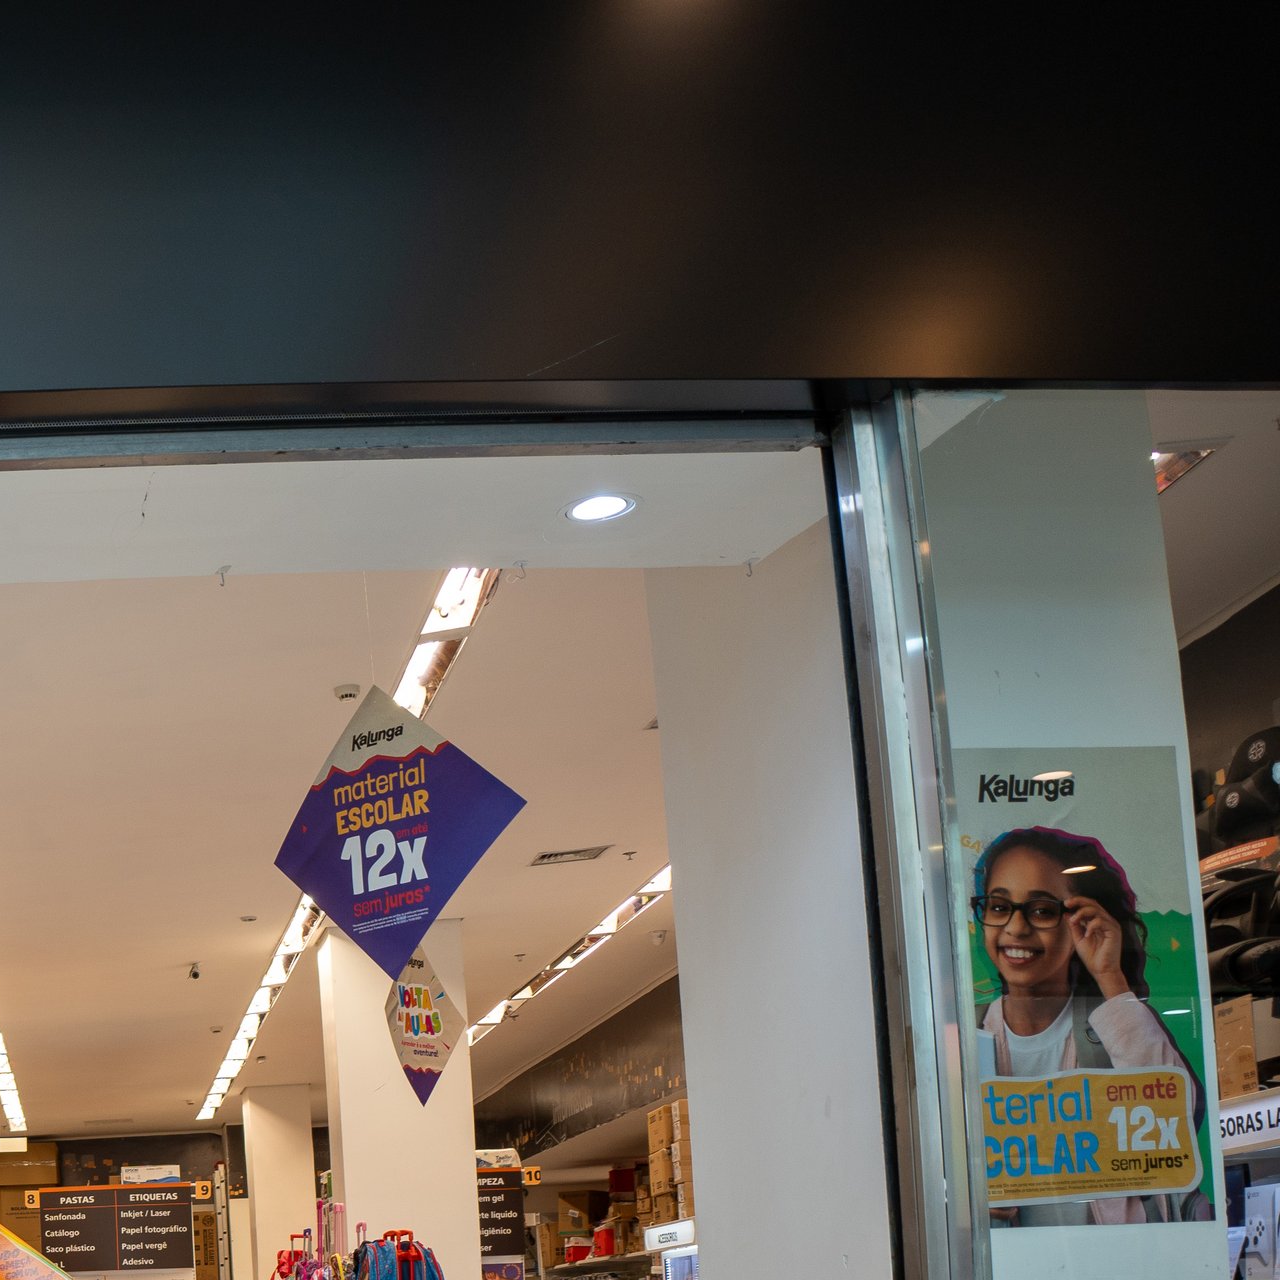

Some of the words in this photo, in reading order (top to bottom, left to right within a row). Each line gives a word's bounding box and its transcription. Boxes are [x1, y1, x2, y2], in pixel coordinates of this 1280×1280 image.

[333, 759, 426, 806] material
[336, 789, 429, 835] ESCOLAR
[342, 829, 428, 896] 12x
[353, 899, 383, 918] sem
[398, 985, 432, 1010] VOLTA
[405, 1012, 441, 1036] AULAS
[1107, 1084, 1136, 1101] em
[1142, 1077, 1177, 1100] até
[1108, 1106, 1181, 1152] 12x
[1112, 1156, 1141, 1171] sem
[60, 1196, 94, 1204] PASTAS
[130, 1193, 177, 1201] ETIQUETAS
[492, 1194, 504, 1203] gel
[45, 1213, 86, 1221] Sanfonada
[45, 1229, 79, 1238] Catálogo
[121, 1226, 142, 1234] Papel
[145, 1225, 187, 1234] fotográfico
[46, 1245, 64, 1253] Saco
[66, 1244, 95, 1253] plástico
[122, 1243, 142, 1251] Papel
